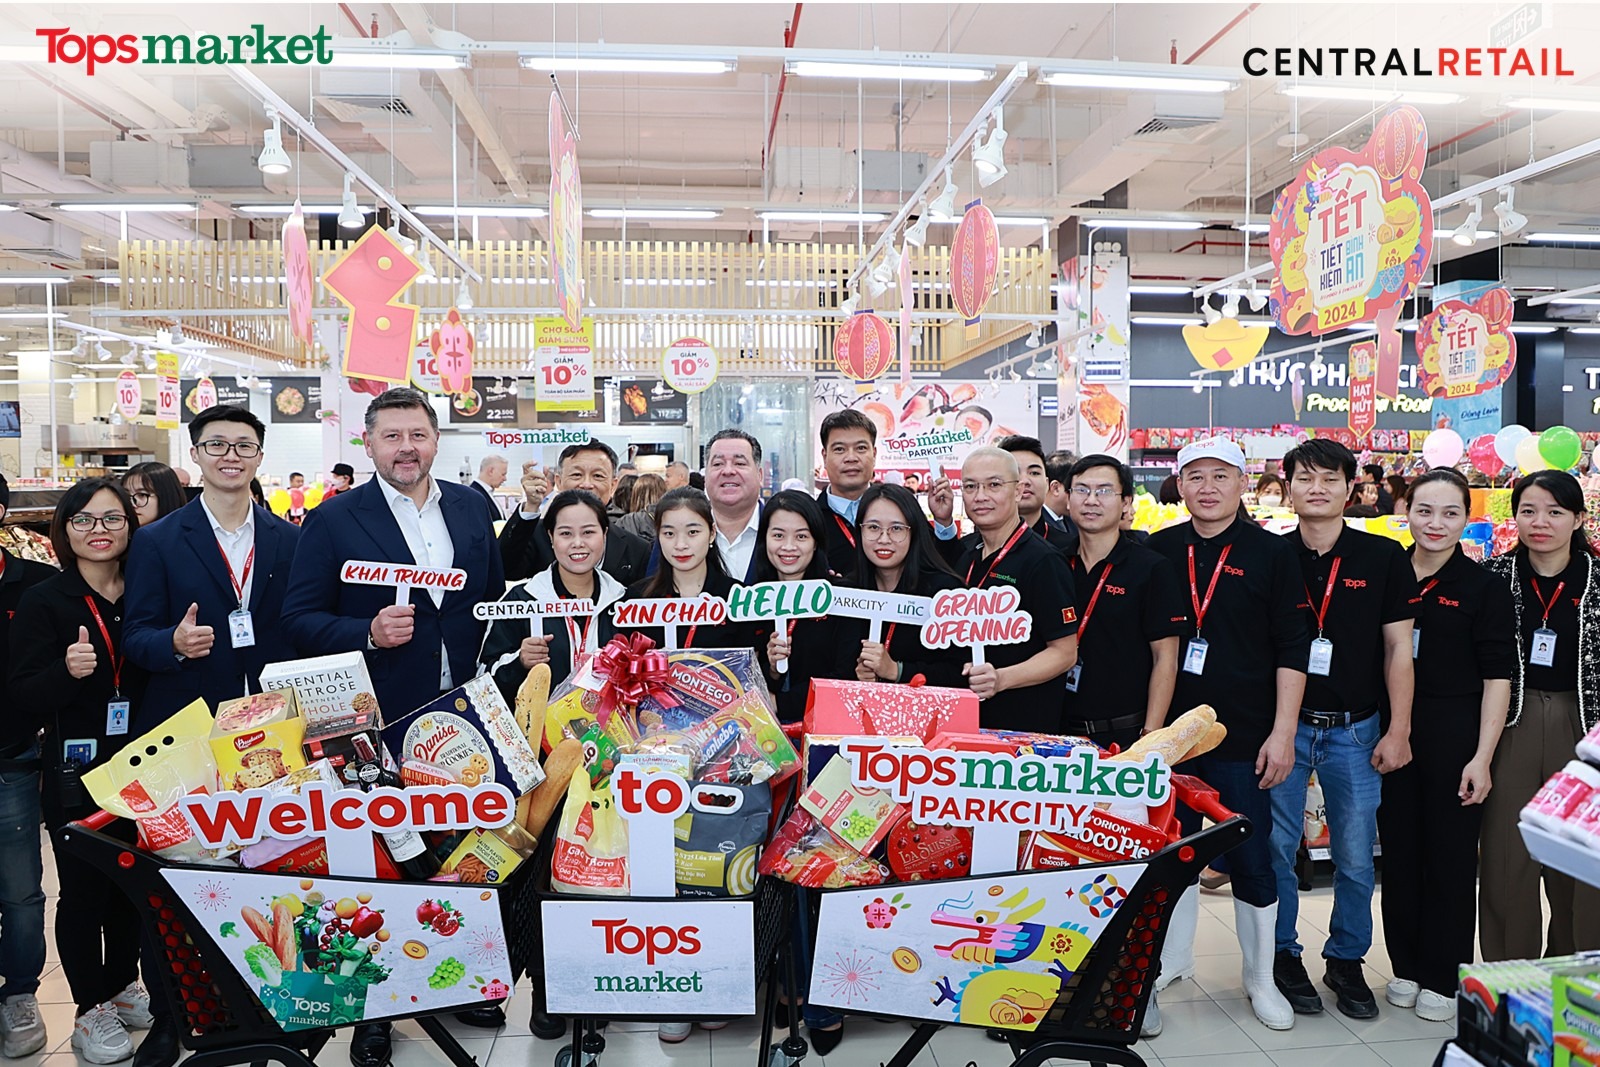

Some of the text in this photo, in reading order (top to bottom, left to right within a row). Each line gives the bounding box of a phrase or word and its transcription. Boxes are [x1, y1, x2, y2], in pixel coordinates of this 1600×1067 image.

[1318, 177, 1367, 244] TẾT
[1320, 240, 1343, 270] TIẾT
[1346, 252, 1364, 284] AN
[1320, 268, 1342, 292] KIỆM
[1324, 300, 1357, 326] 2024
[1447, 318, 1478, 350] TẾT
[541, 364, 587, 385] 10%
[671, 358, 710, 376] 10%
[1451, 384, 1471, 395] 2024
[908, 445, 954, 458] PARKCITY
[345, 564, 389, 583] KHAI
[1223, 565, 1245, 576] Tops
[1105, 584, 1126, 595] Tops
[1343, 578, 1367, 589] Tops
[616, 603, 657, 624] XIN
[662, 596, 725, 623] CHÀO
[729, 583, 832, 618] HELLO
[935, 591, 1016, 618] GRAND
[1438, 596, 1459, 607] Tops
[926, 616, 1028, 644] OPENING
[267, 670, 353, 690] ESSENTIAL
[298, 681, 357, 698] ITROSE
[671, 669, 733, 703] MONTEGO
[413, 724, 460, 763] Danisa
[617, 771, 683, 814] to
[187, 789, 508, 844] Welcome
[919, 796, 1088, 827] PARKCITY
[1093, 817, 1129, 835] ORION
[477, 838, 491, 852] SALTED
[592, 918, 702, 965] Tops
[594, 971, 703, 993] market
[291, 997, 331, 1015] Tops
[289, 1015, 329, 1027] market
